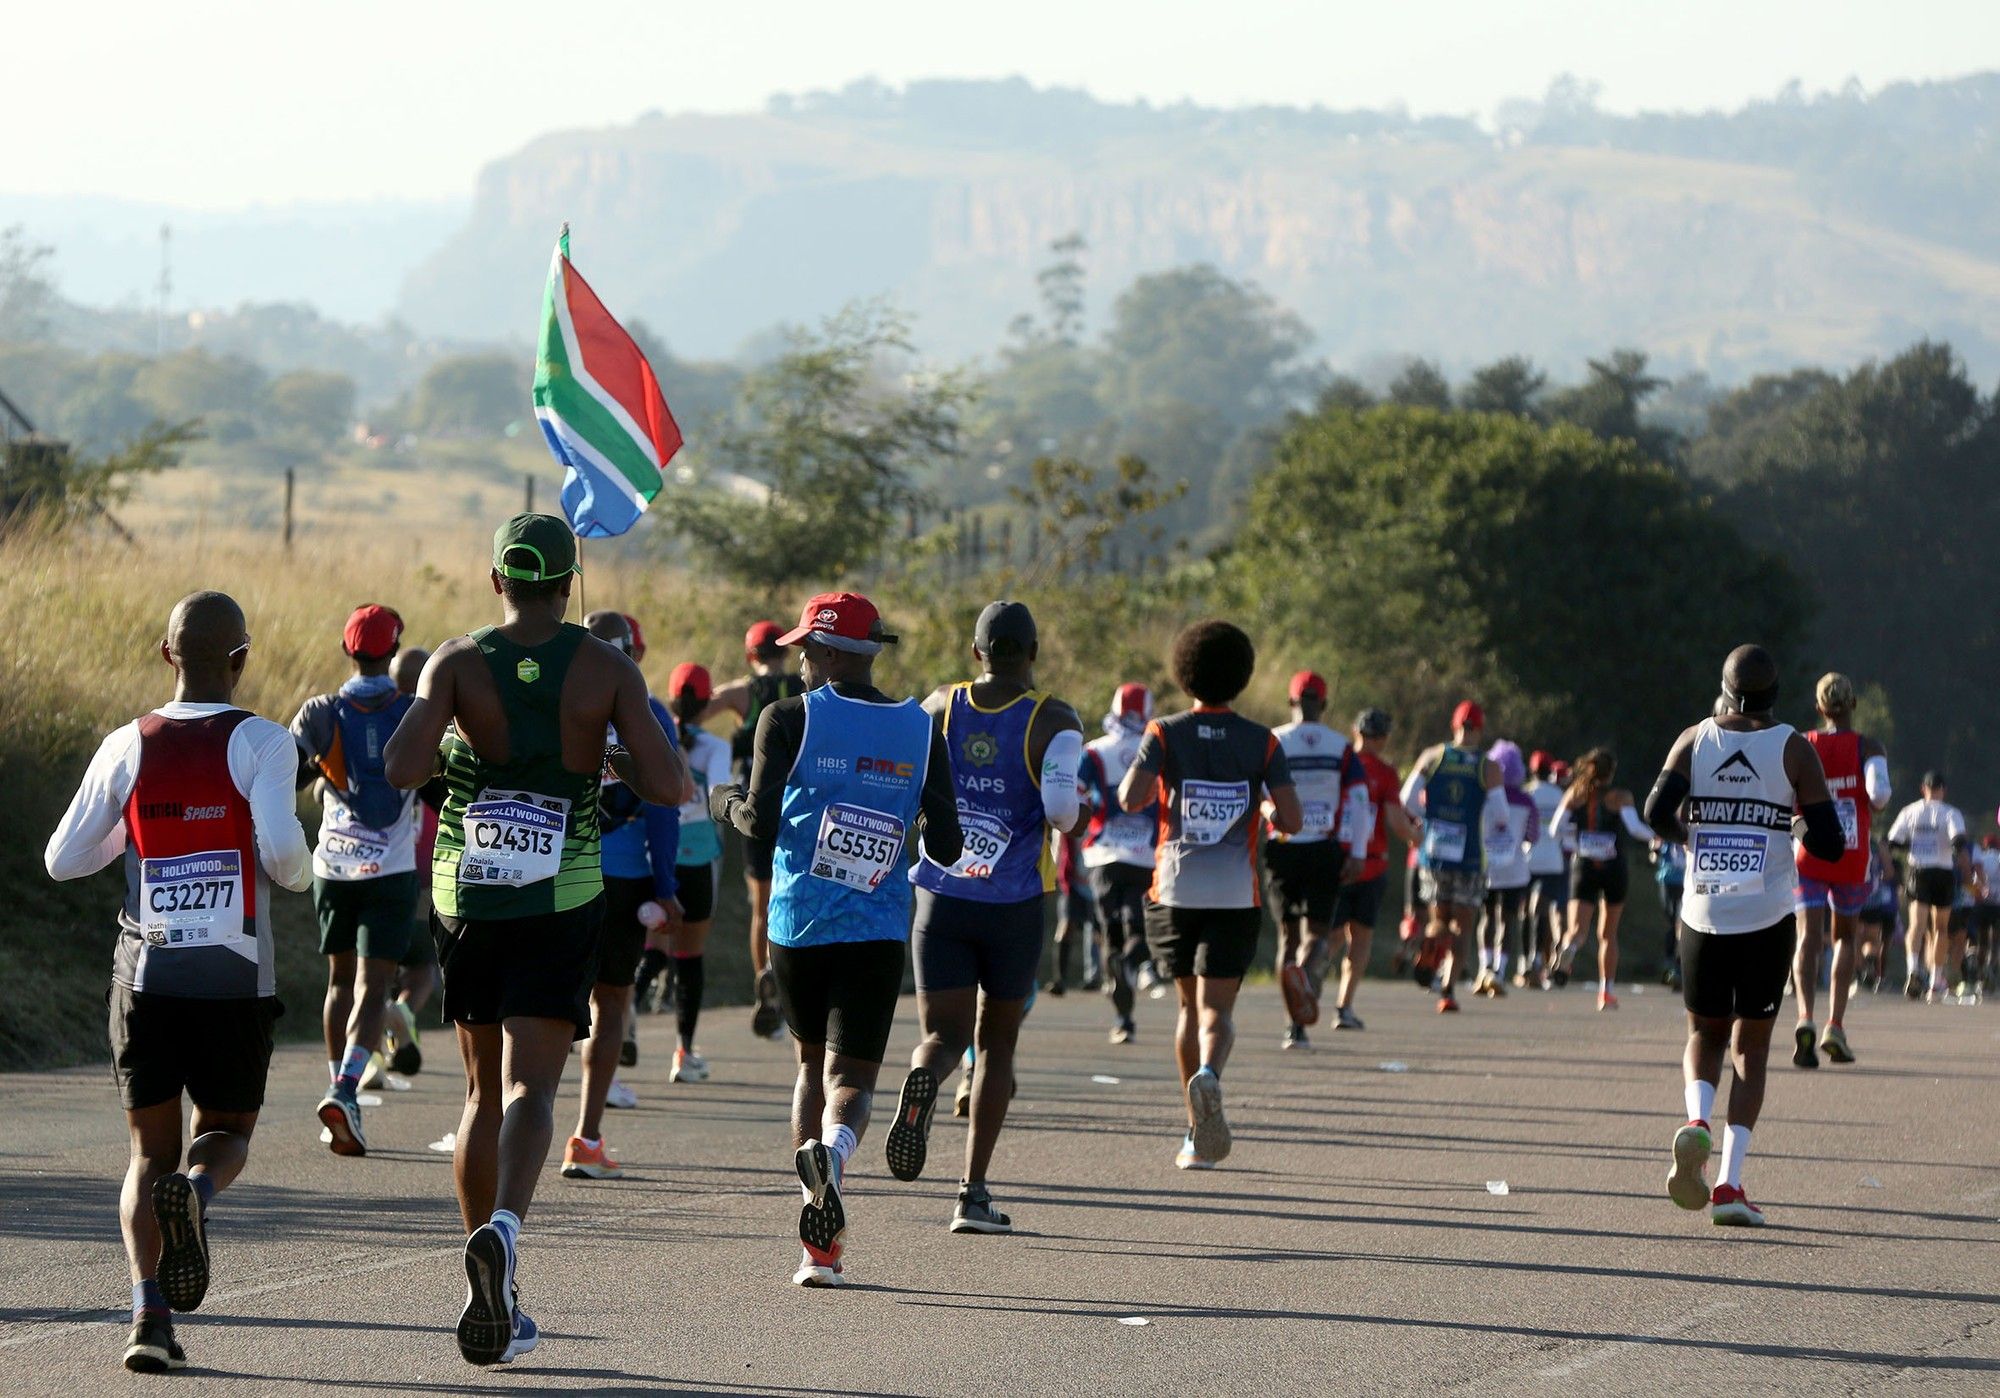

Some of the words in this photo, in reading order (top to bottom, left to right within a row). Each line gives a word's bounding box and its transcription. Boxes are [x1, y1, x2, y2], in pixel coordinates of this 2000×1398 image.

[813, 621, 835, 631] TOYOTA
[817, 757, 847, 769] HBIS
[863, 773, 910, 785] PALABORA
[1717, 774, 1752, 783] K-WAY
[1188, 802, 1245, 821] C43577
[1692, 801, 1737, 822] -WAY
[840, 811, 895, 833] HOLLYWOOD
[475, 823, 553, 855] C24313
[1708, 837, 1754, 848] HOLLYWOOD
[326, 837, 384, 860] C30627
[827, 828, 895, 866] C55351
[820, 855, 837, 866] Mpho
[1699, 852, 1760, 872] C55692
[162, 860, 222, 878] HOLLYWOOD
[222, 863, 238, 872] bets
[466, 865, 481, 874] ASA
[503, 872, 509, 880] 2
[150, 880, 234, 913] C32277
[147, 932, 165, 941] ASA
[187, 932, 194, 940] 5
